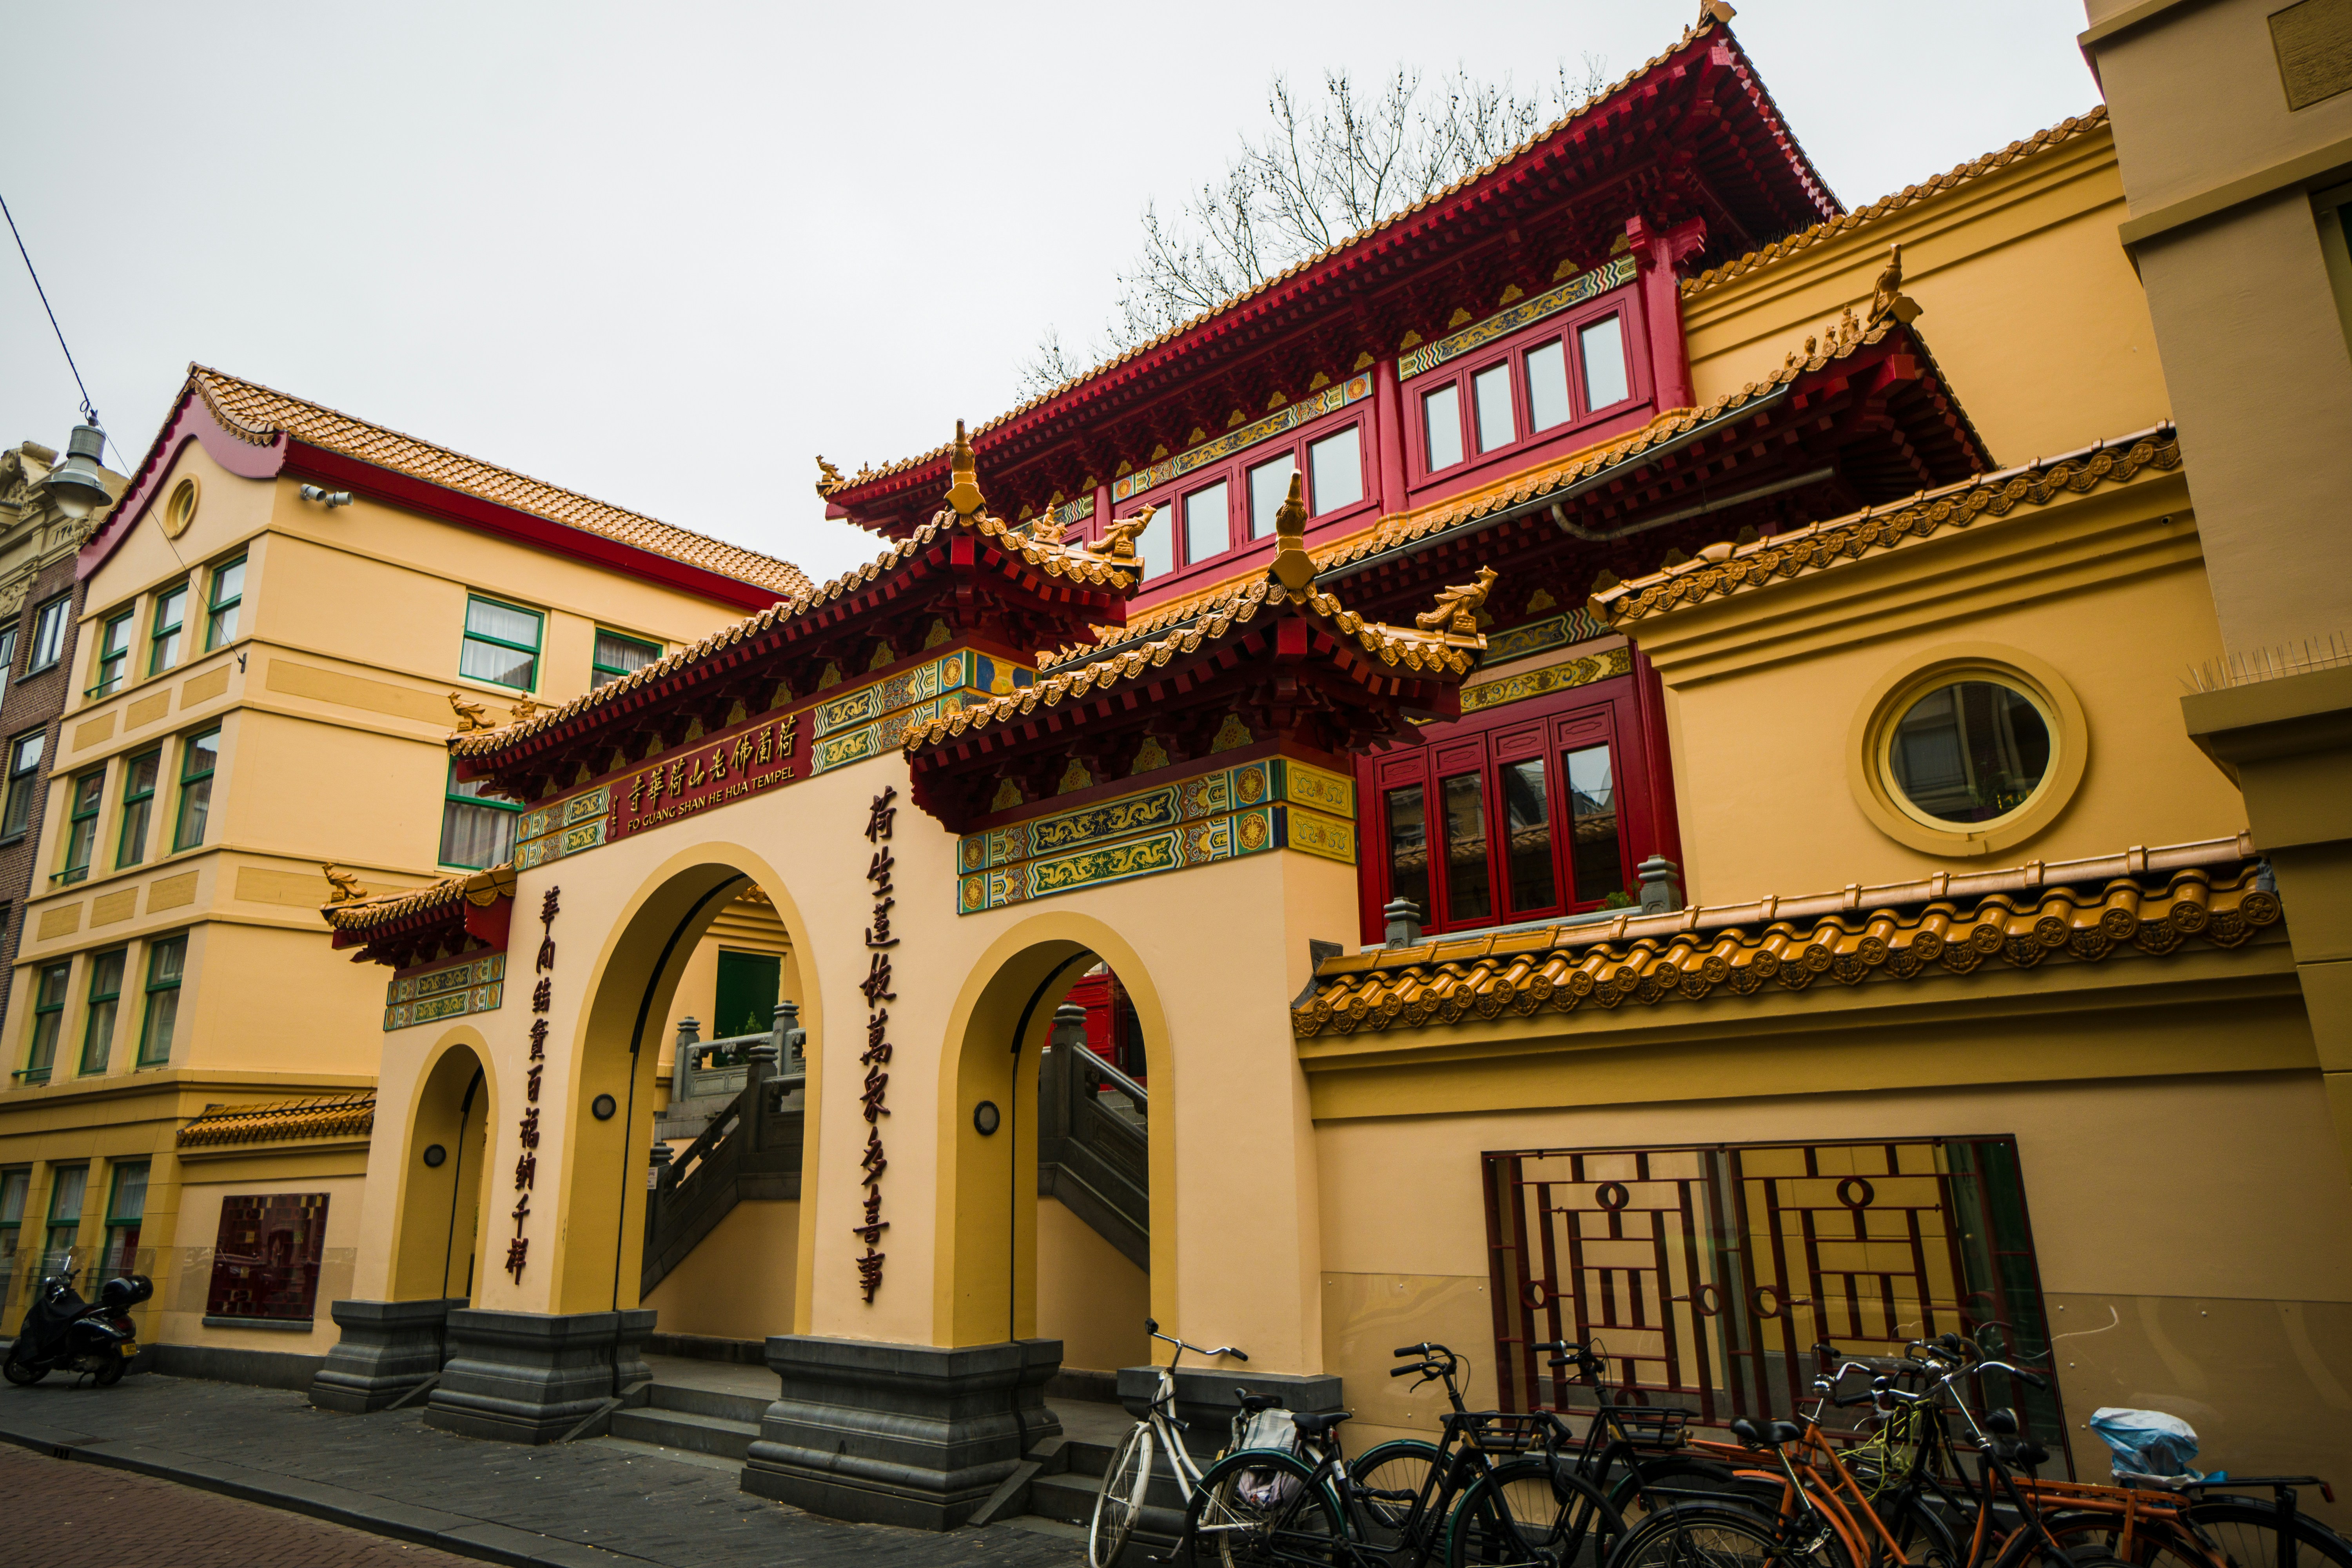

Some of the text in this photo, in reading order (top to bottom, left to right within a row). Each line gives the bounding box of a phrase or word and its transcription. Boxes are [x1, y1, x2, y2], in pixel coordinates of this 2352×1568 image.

[628, 766, 795, 831] FO GUANG SHAN HE HUA TEMPEL
[1428, 1506, 1441, 1535] VANMOOF
